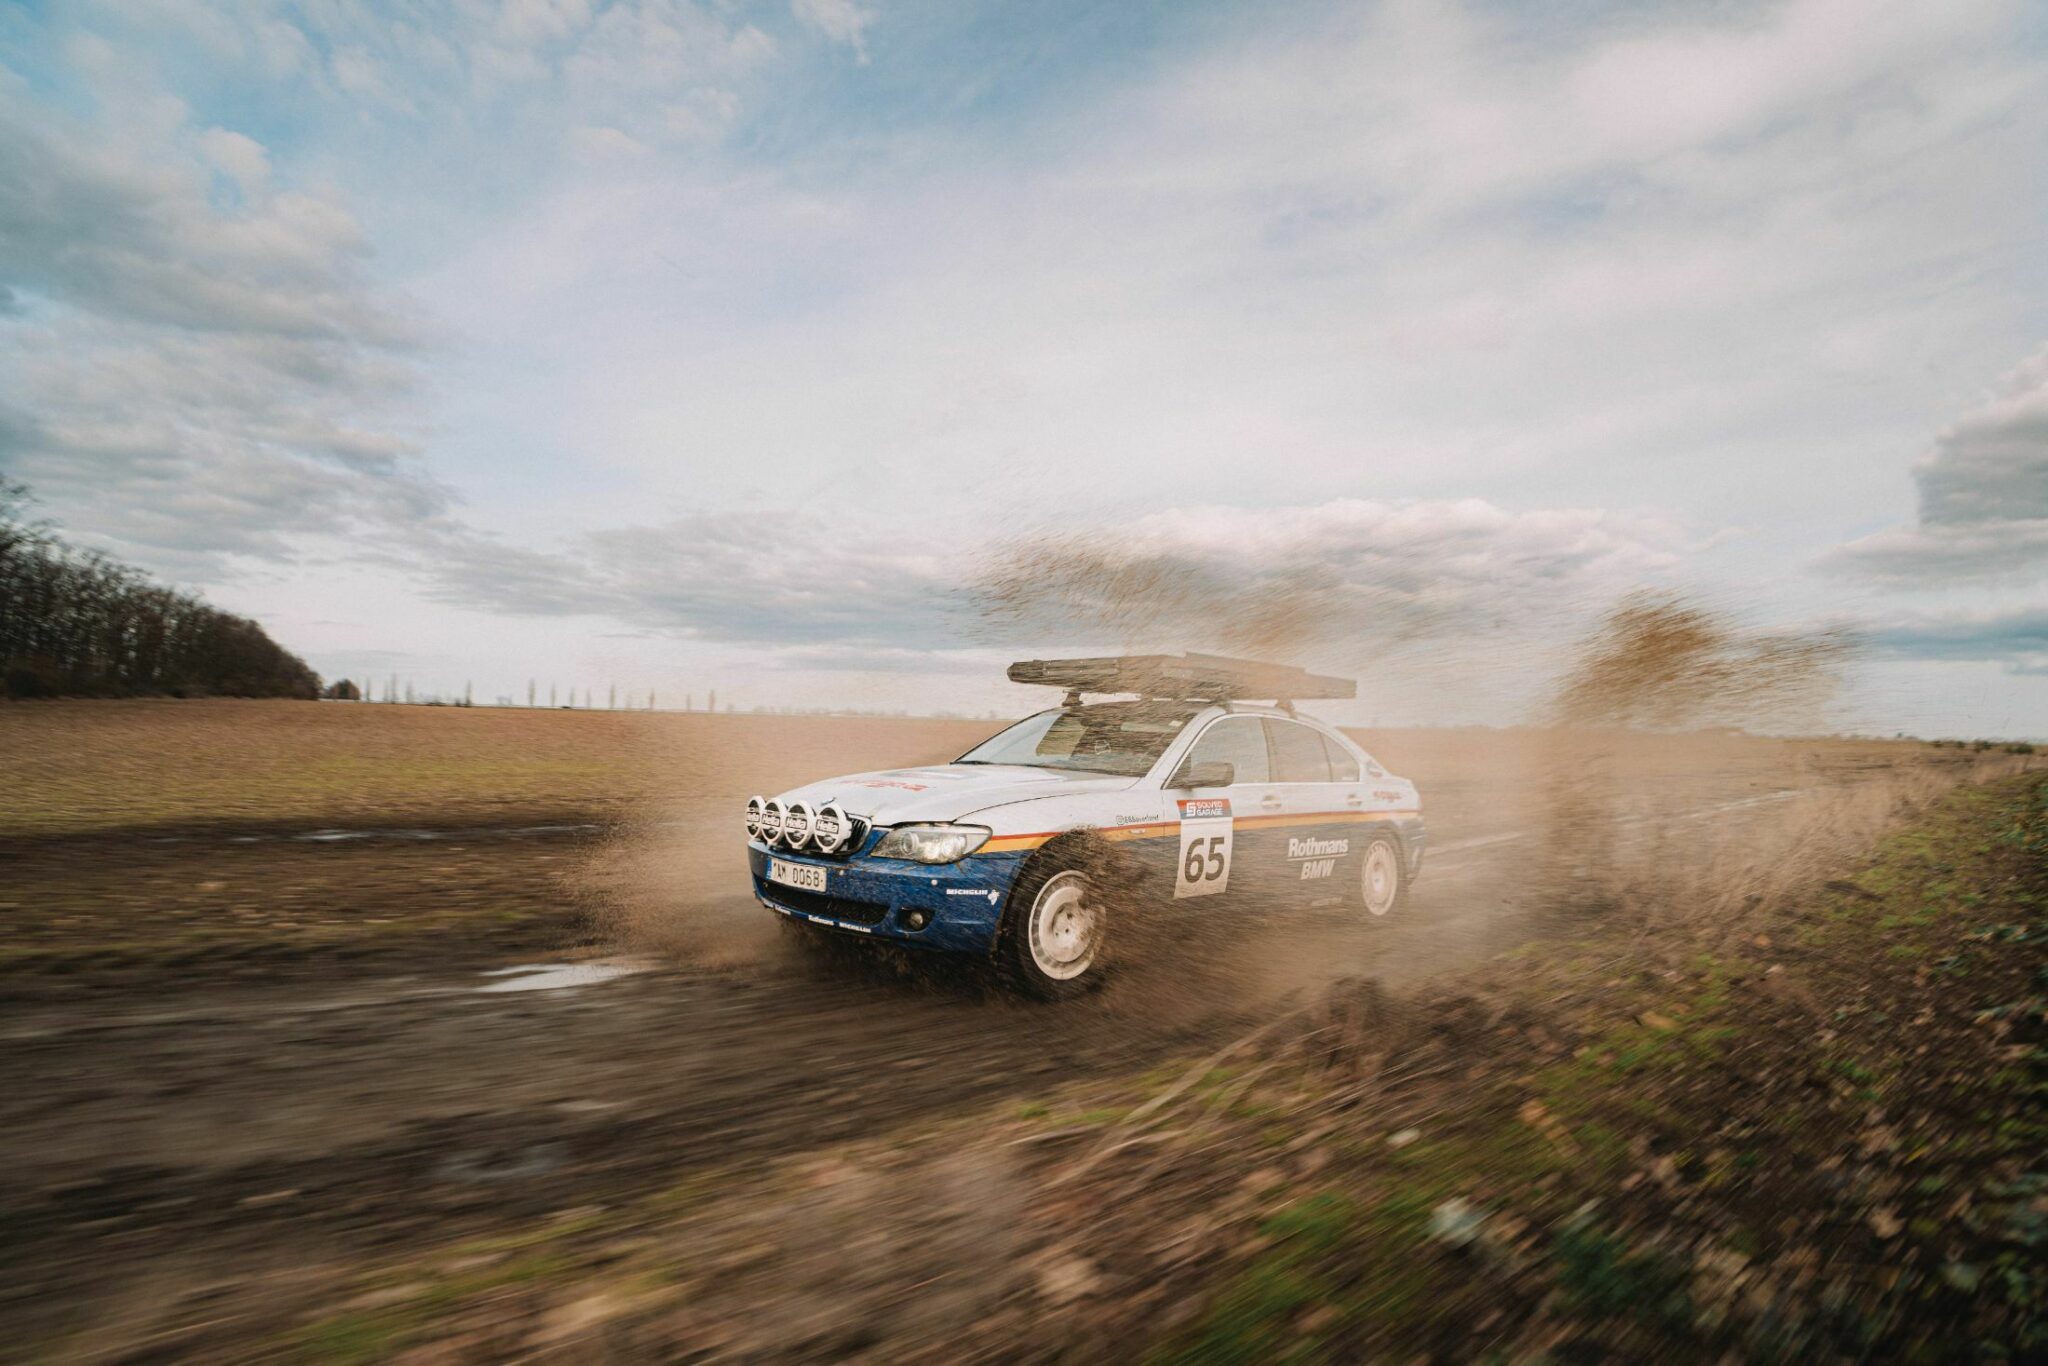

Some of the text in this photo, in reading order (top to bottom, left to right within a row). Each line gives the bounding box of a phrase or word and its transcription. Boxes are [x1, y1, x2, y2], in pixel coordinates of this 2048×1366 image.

[1196, 800, 1223, 809] SOLVED
[1196, 808, 1224, 816] GARAGE
[762, 814, 780, 826] Hella
[786, 817, 807, 829] Hella
[816, 820, 839, 833] Hella
[1288, 837, 1349, 857] Rothmans
[1184, 836, 1225, 883] 65
[1301, 859, 1336, 880] BMW
[793, 867, 820, 887] 0068
